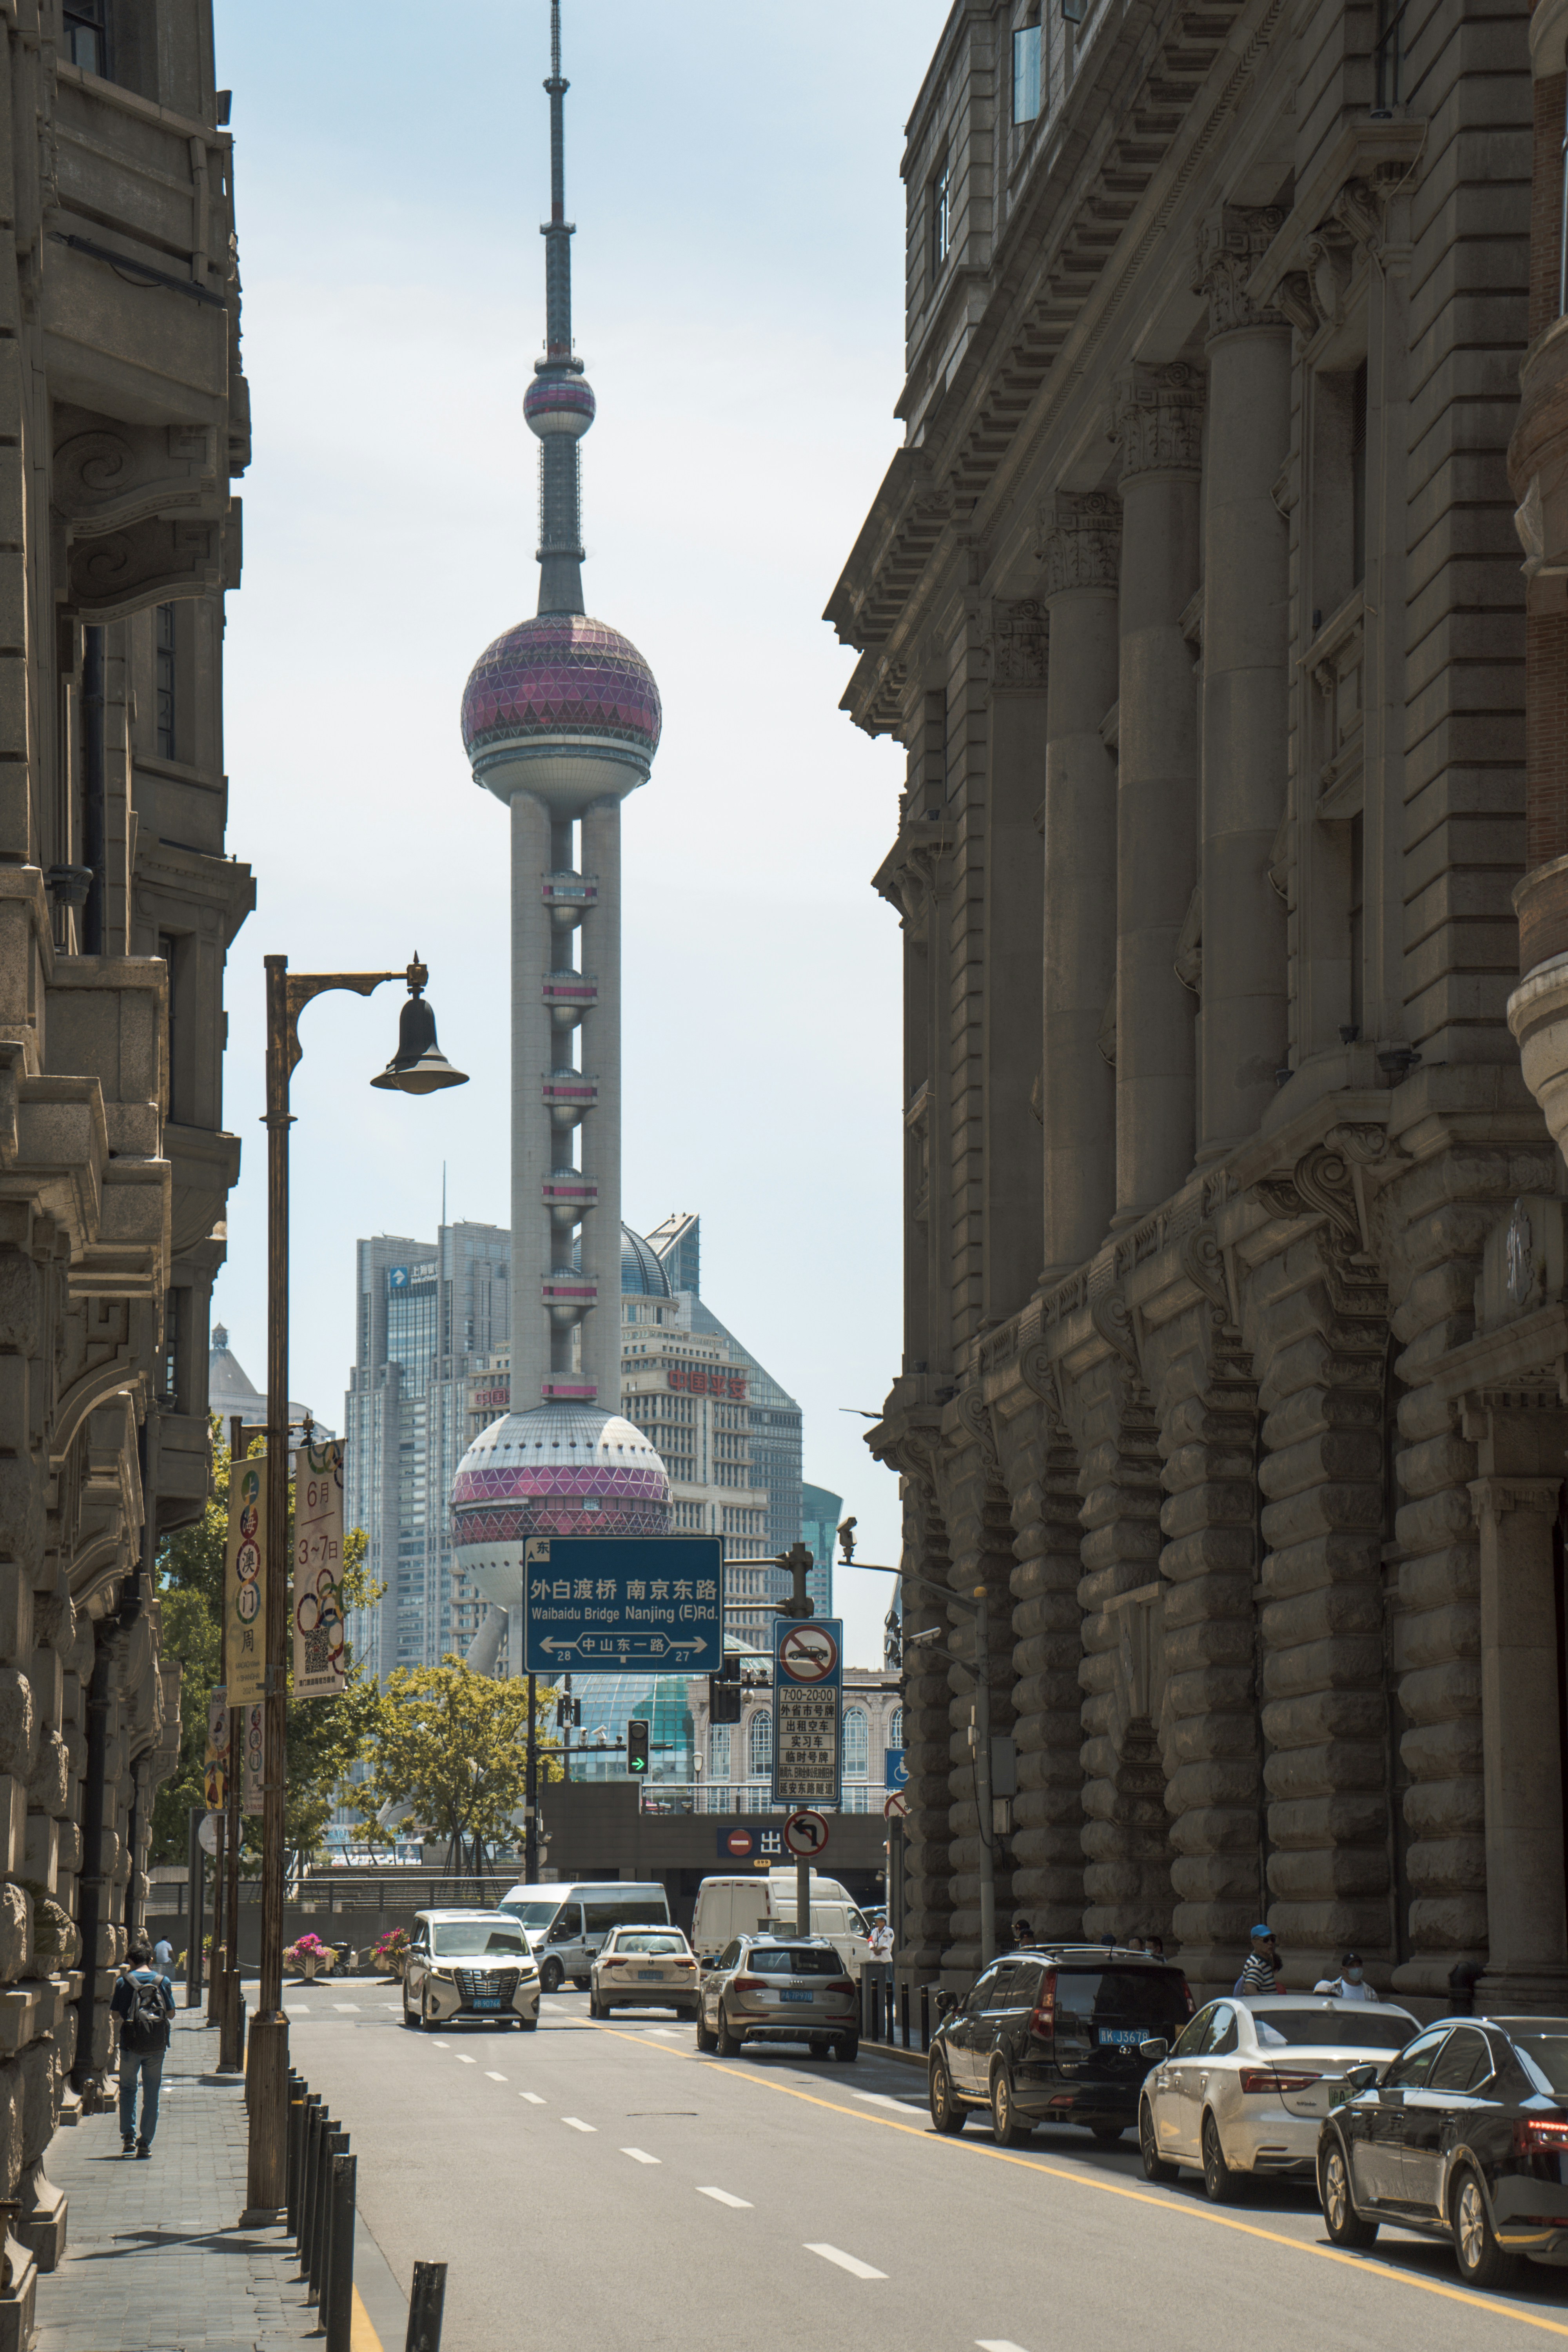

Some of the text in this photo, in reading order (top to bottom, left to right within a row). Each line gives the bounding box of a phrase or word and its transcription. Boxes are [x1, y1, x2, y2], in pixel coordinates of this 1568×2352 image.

[669, 1368, 746, 1399] 中国平安
[475, 1388, 510, 1406] 中国
[307, 1480, 329, 1508] 6月
[536, 1541, 550, 1554] 东
[241, 1477, 256, 1654] 上海澳门周
[530, 1579, 717, 1601] 外白渡桥 南京东路
[532, 1607, 581, 1620] Waibaidu
[584, 1607, 619, 1623] Bridge
[625, 1606, 674, 1623] Nanjing
[583, 1638, 664, 1652] 中山东一路
[557, 1651, 571, 1662] 28
[675, 1651, 689, 1662] 27
[243, 1687, 254, 1695] 2021
[782, 1689, 833, 1701] 7:00-20:00
[781, 1704, 835, 1717] 外省市号牌
[786, 1720, 829, 1733] 出租空车
[791, 1735, 823, 1748] 实习车
[786, 1751, 828, 1764] 临时号牌
[780, 1781, 833, 1795] 延安东路隧道
